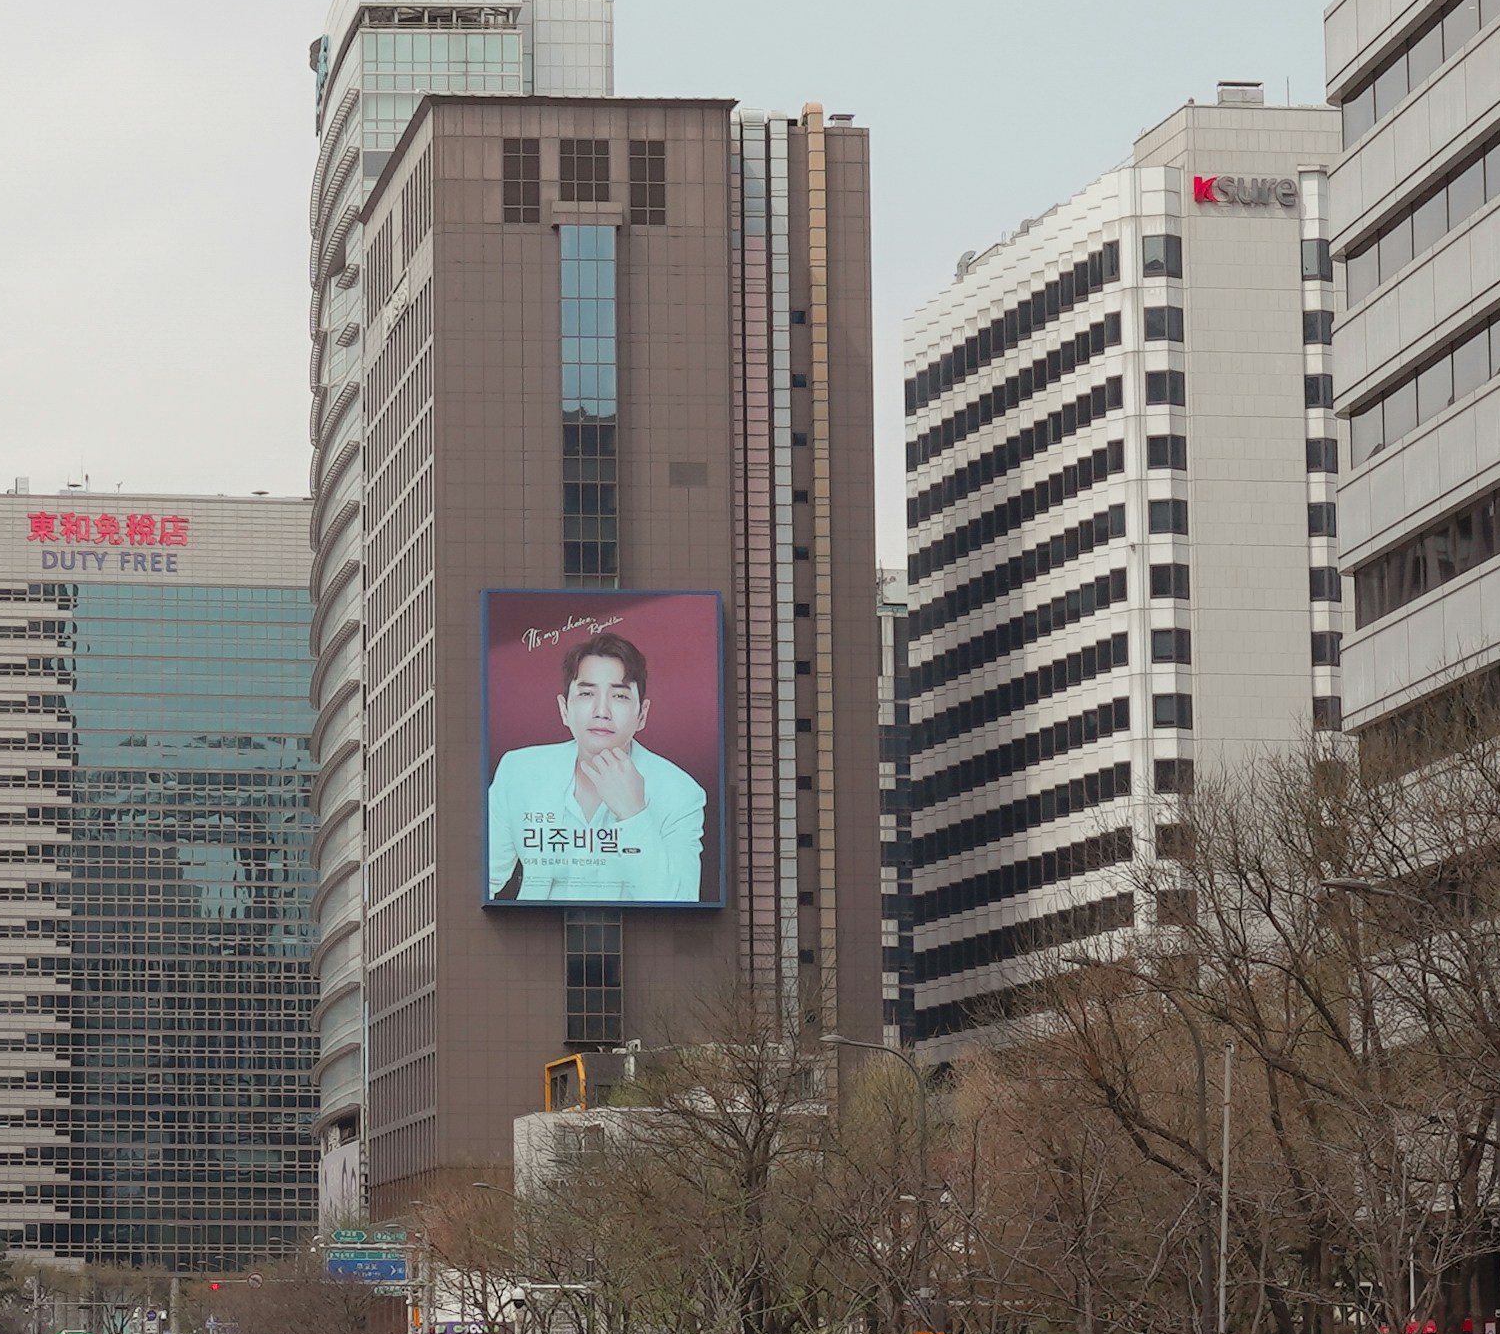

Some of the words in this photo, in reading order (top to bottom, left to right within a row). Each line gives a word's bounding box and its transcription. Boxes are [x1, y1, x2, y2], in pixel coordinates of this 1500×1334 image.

[42, 550, 108, 571] DUTY
[119, 551, 177, 572] FREE
[523, 811, 556, 824] 지금은
[523, 827, 619, 854] 리쥬비엘
